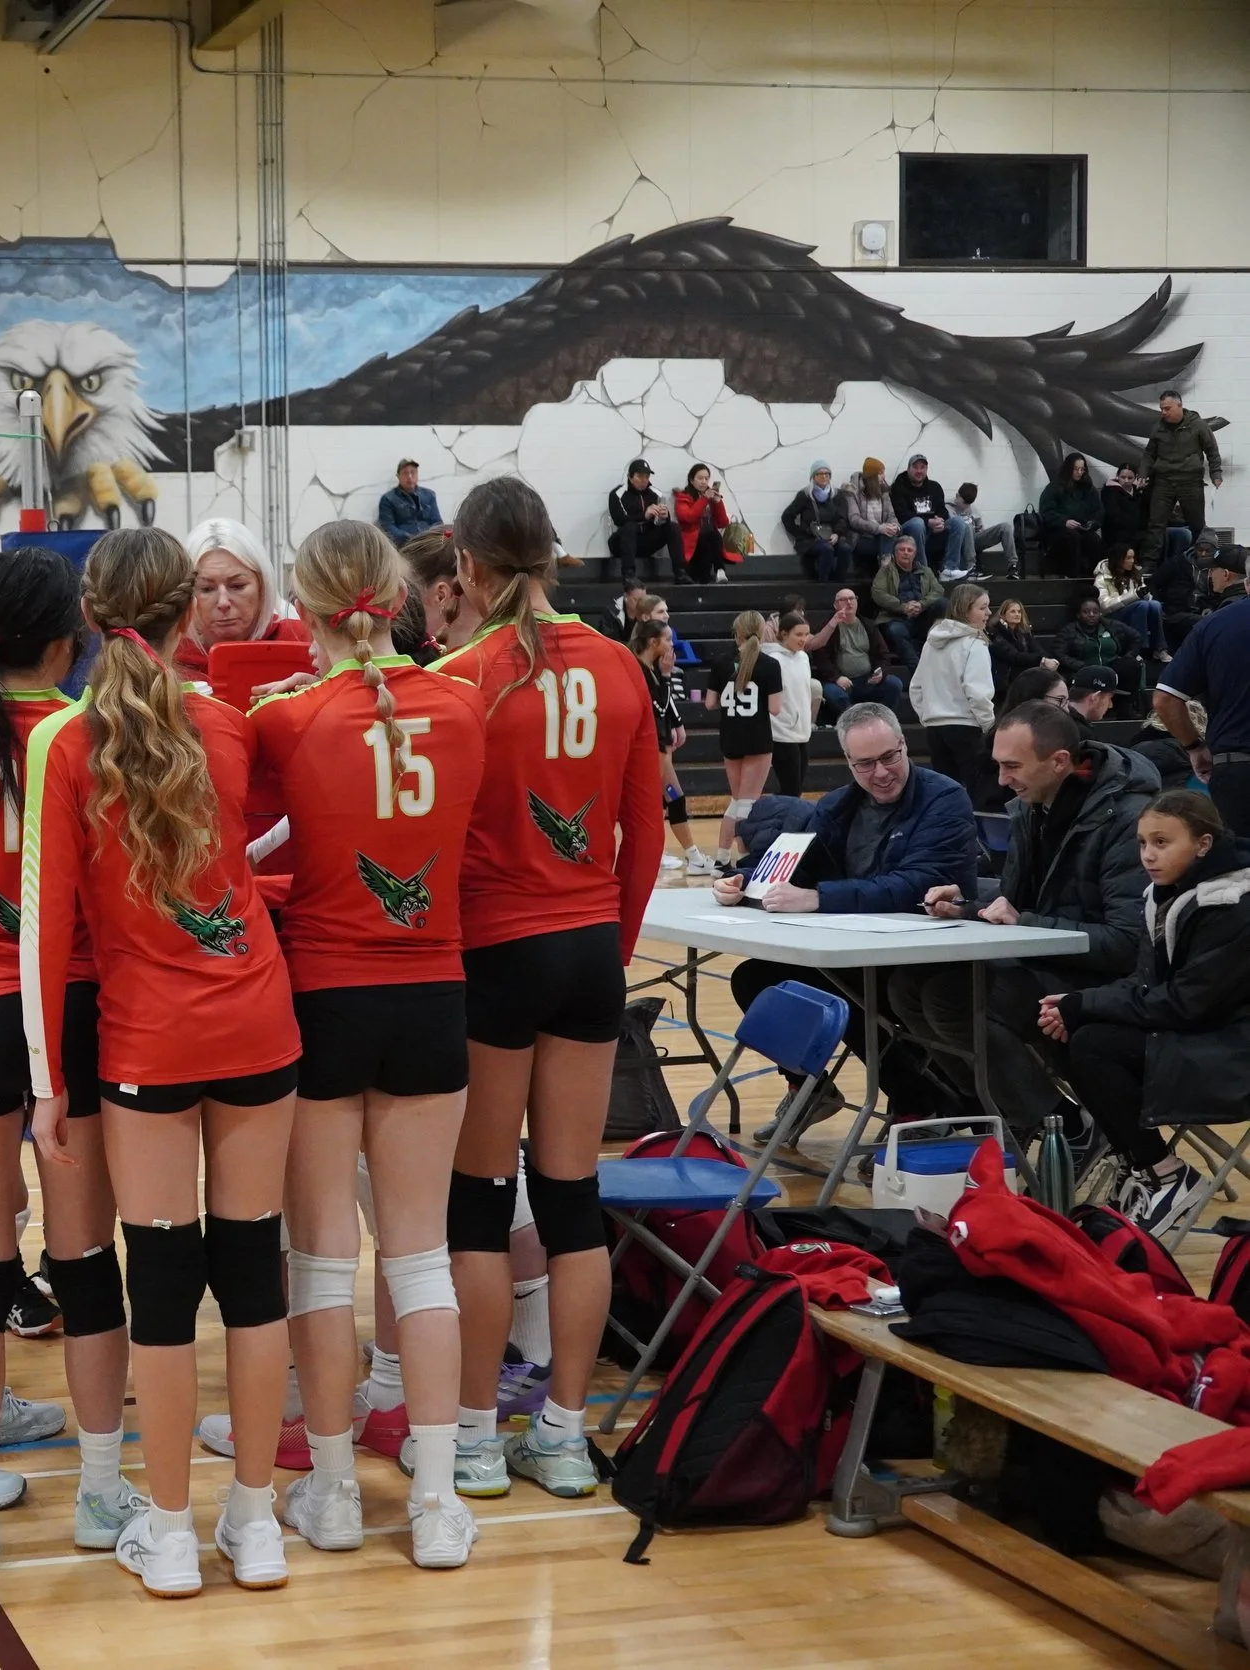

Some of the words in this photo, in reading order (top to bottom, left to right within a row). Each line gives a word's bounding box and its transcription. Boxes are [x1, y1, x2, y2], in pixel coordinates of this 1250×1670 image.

[534, 666, 598, 760] 18
[720, 681, 759, 717] 49
[362, 717, 435, 819] 15
